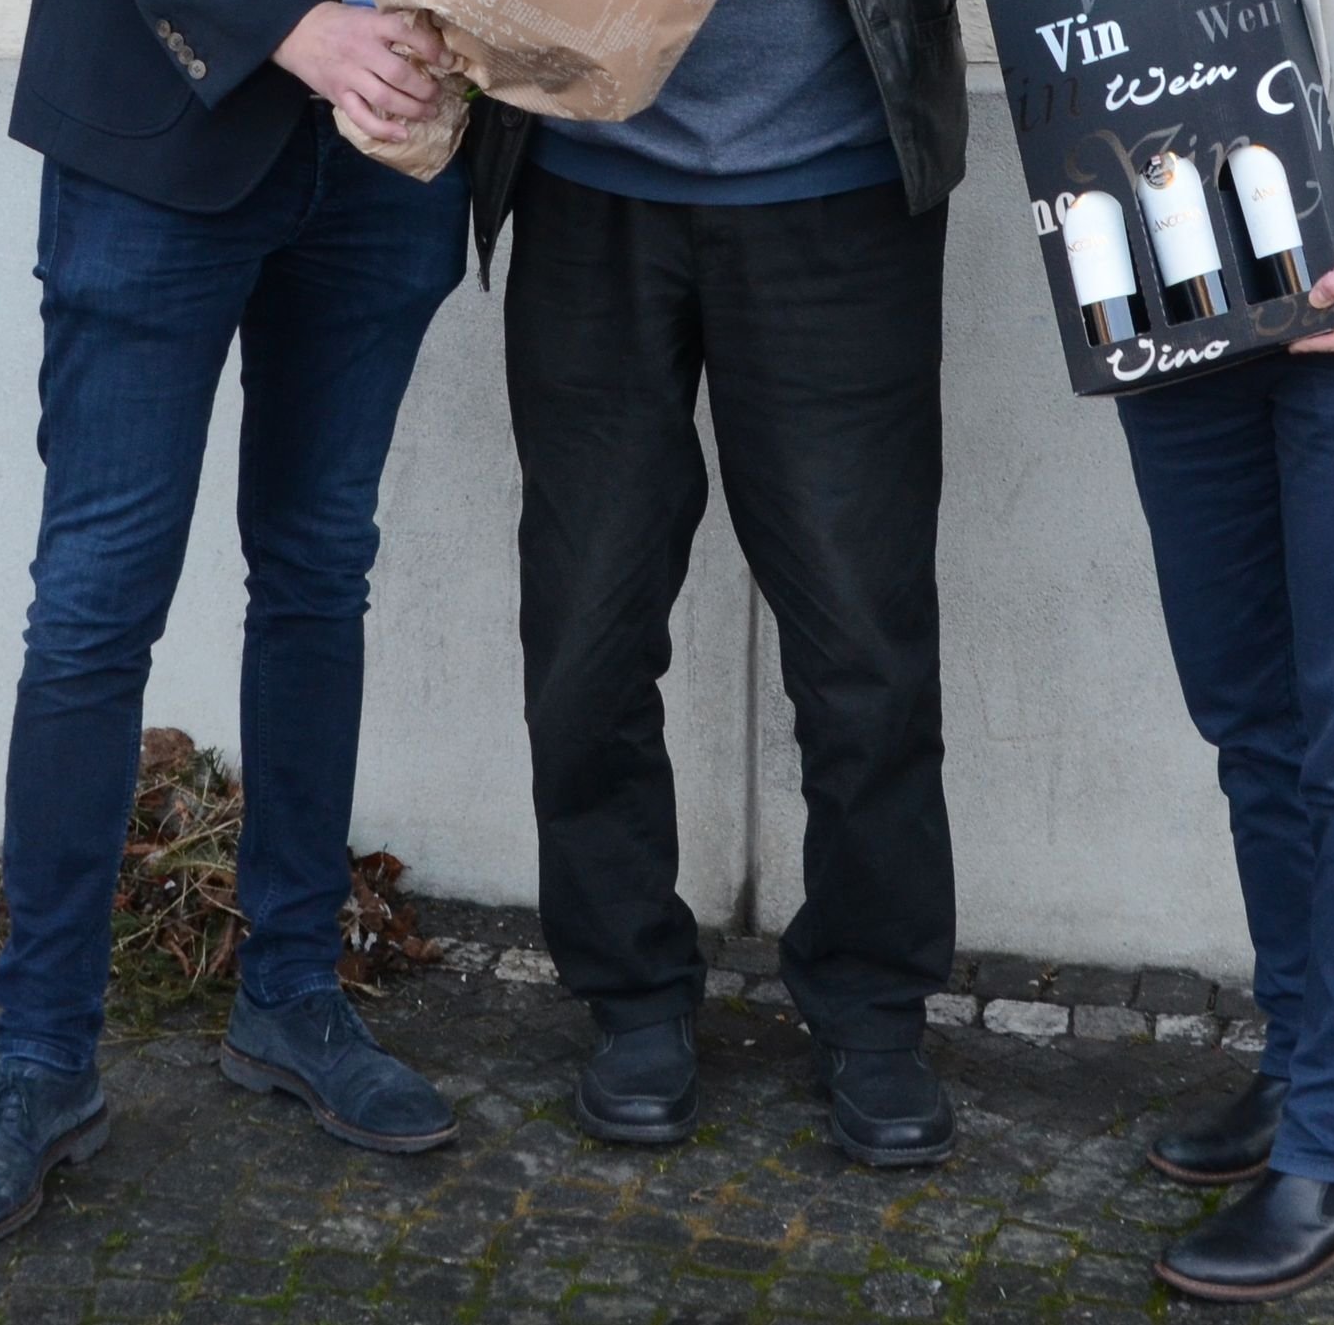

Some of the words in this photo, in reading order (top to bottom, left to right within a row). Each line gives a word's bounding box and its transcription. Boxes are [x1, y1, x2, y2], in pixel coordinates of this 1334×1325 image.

[1035, 13, 1129, 73] Vin
[1104, 60, 1237, 112] Wein
[1107, 337, 1230, 382] Vino
